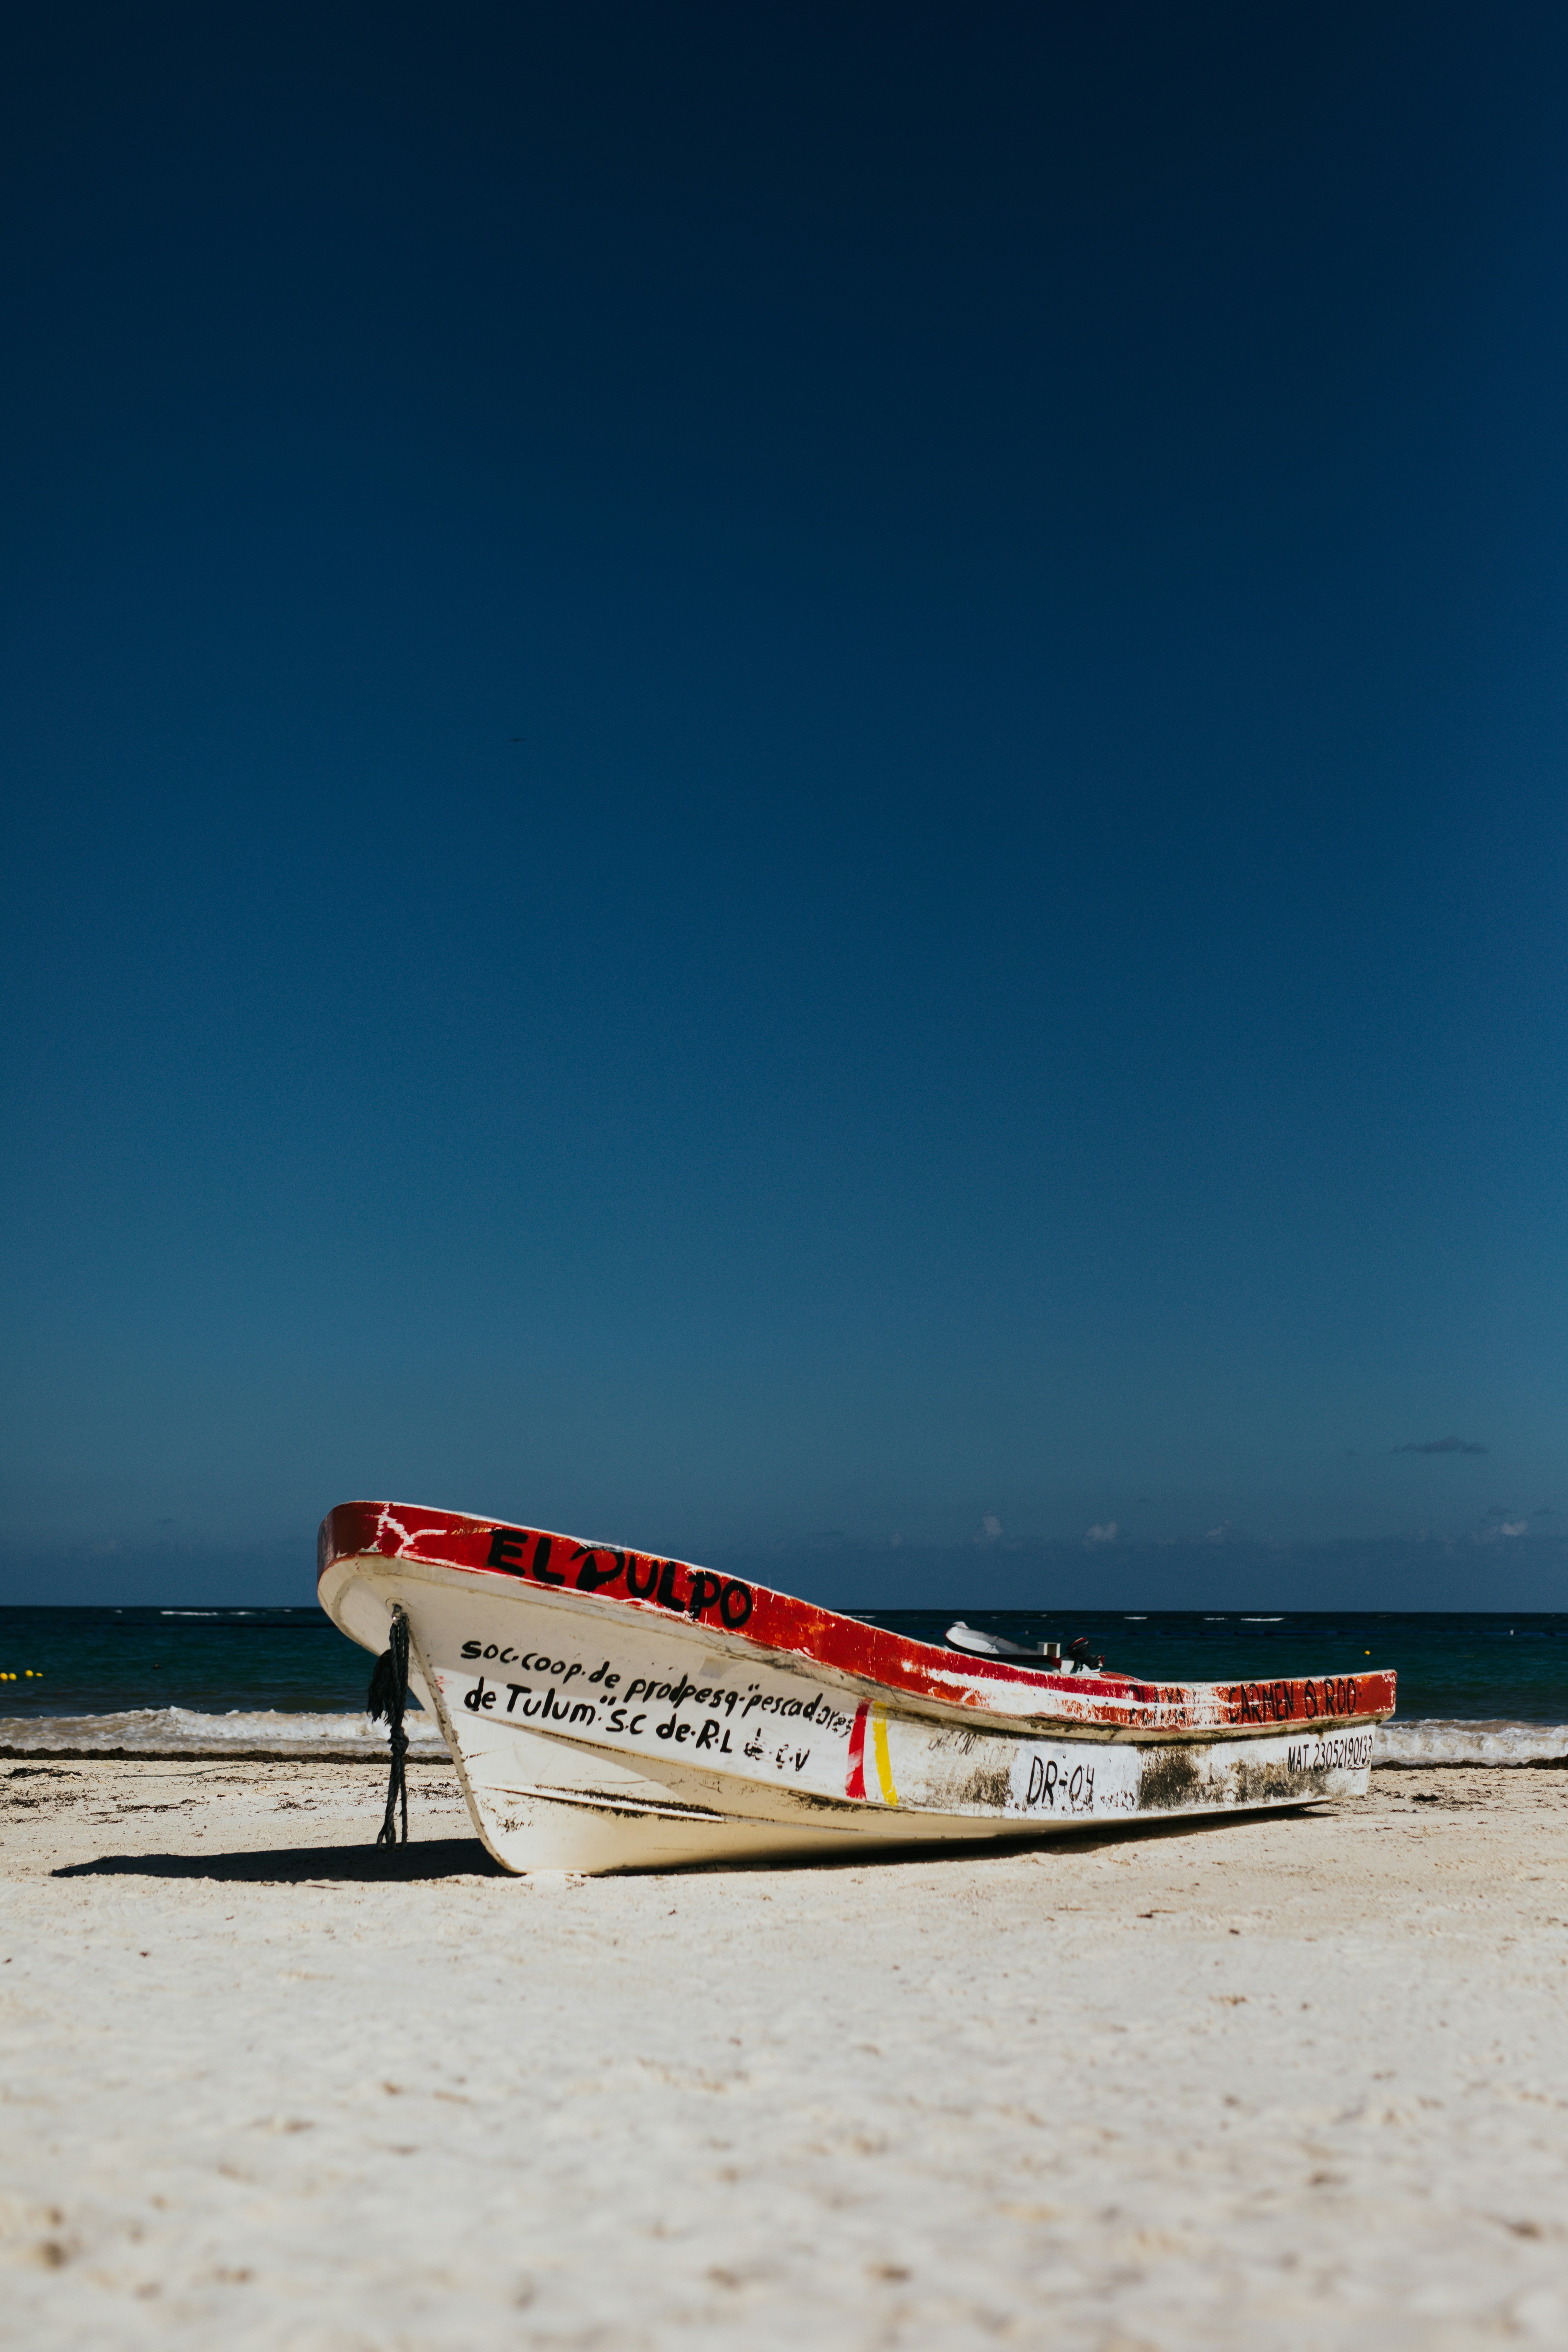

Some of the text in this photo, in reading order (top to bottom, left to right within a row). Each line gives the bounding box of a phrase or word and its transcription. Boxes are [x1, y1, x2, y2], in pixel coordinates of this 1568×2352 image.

[487, 1529, 752, 1628] EL PULPO
[464, 1676, 497, 1712] de
[1229, 1681, 1293, 1724] CARMEN
